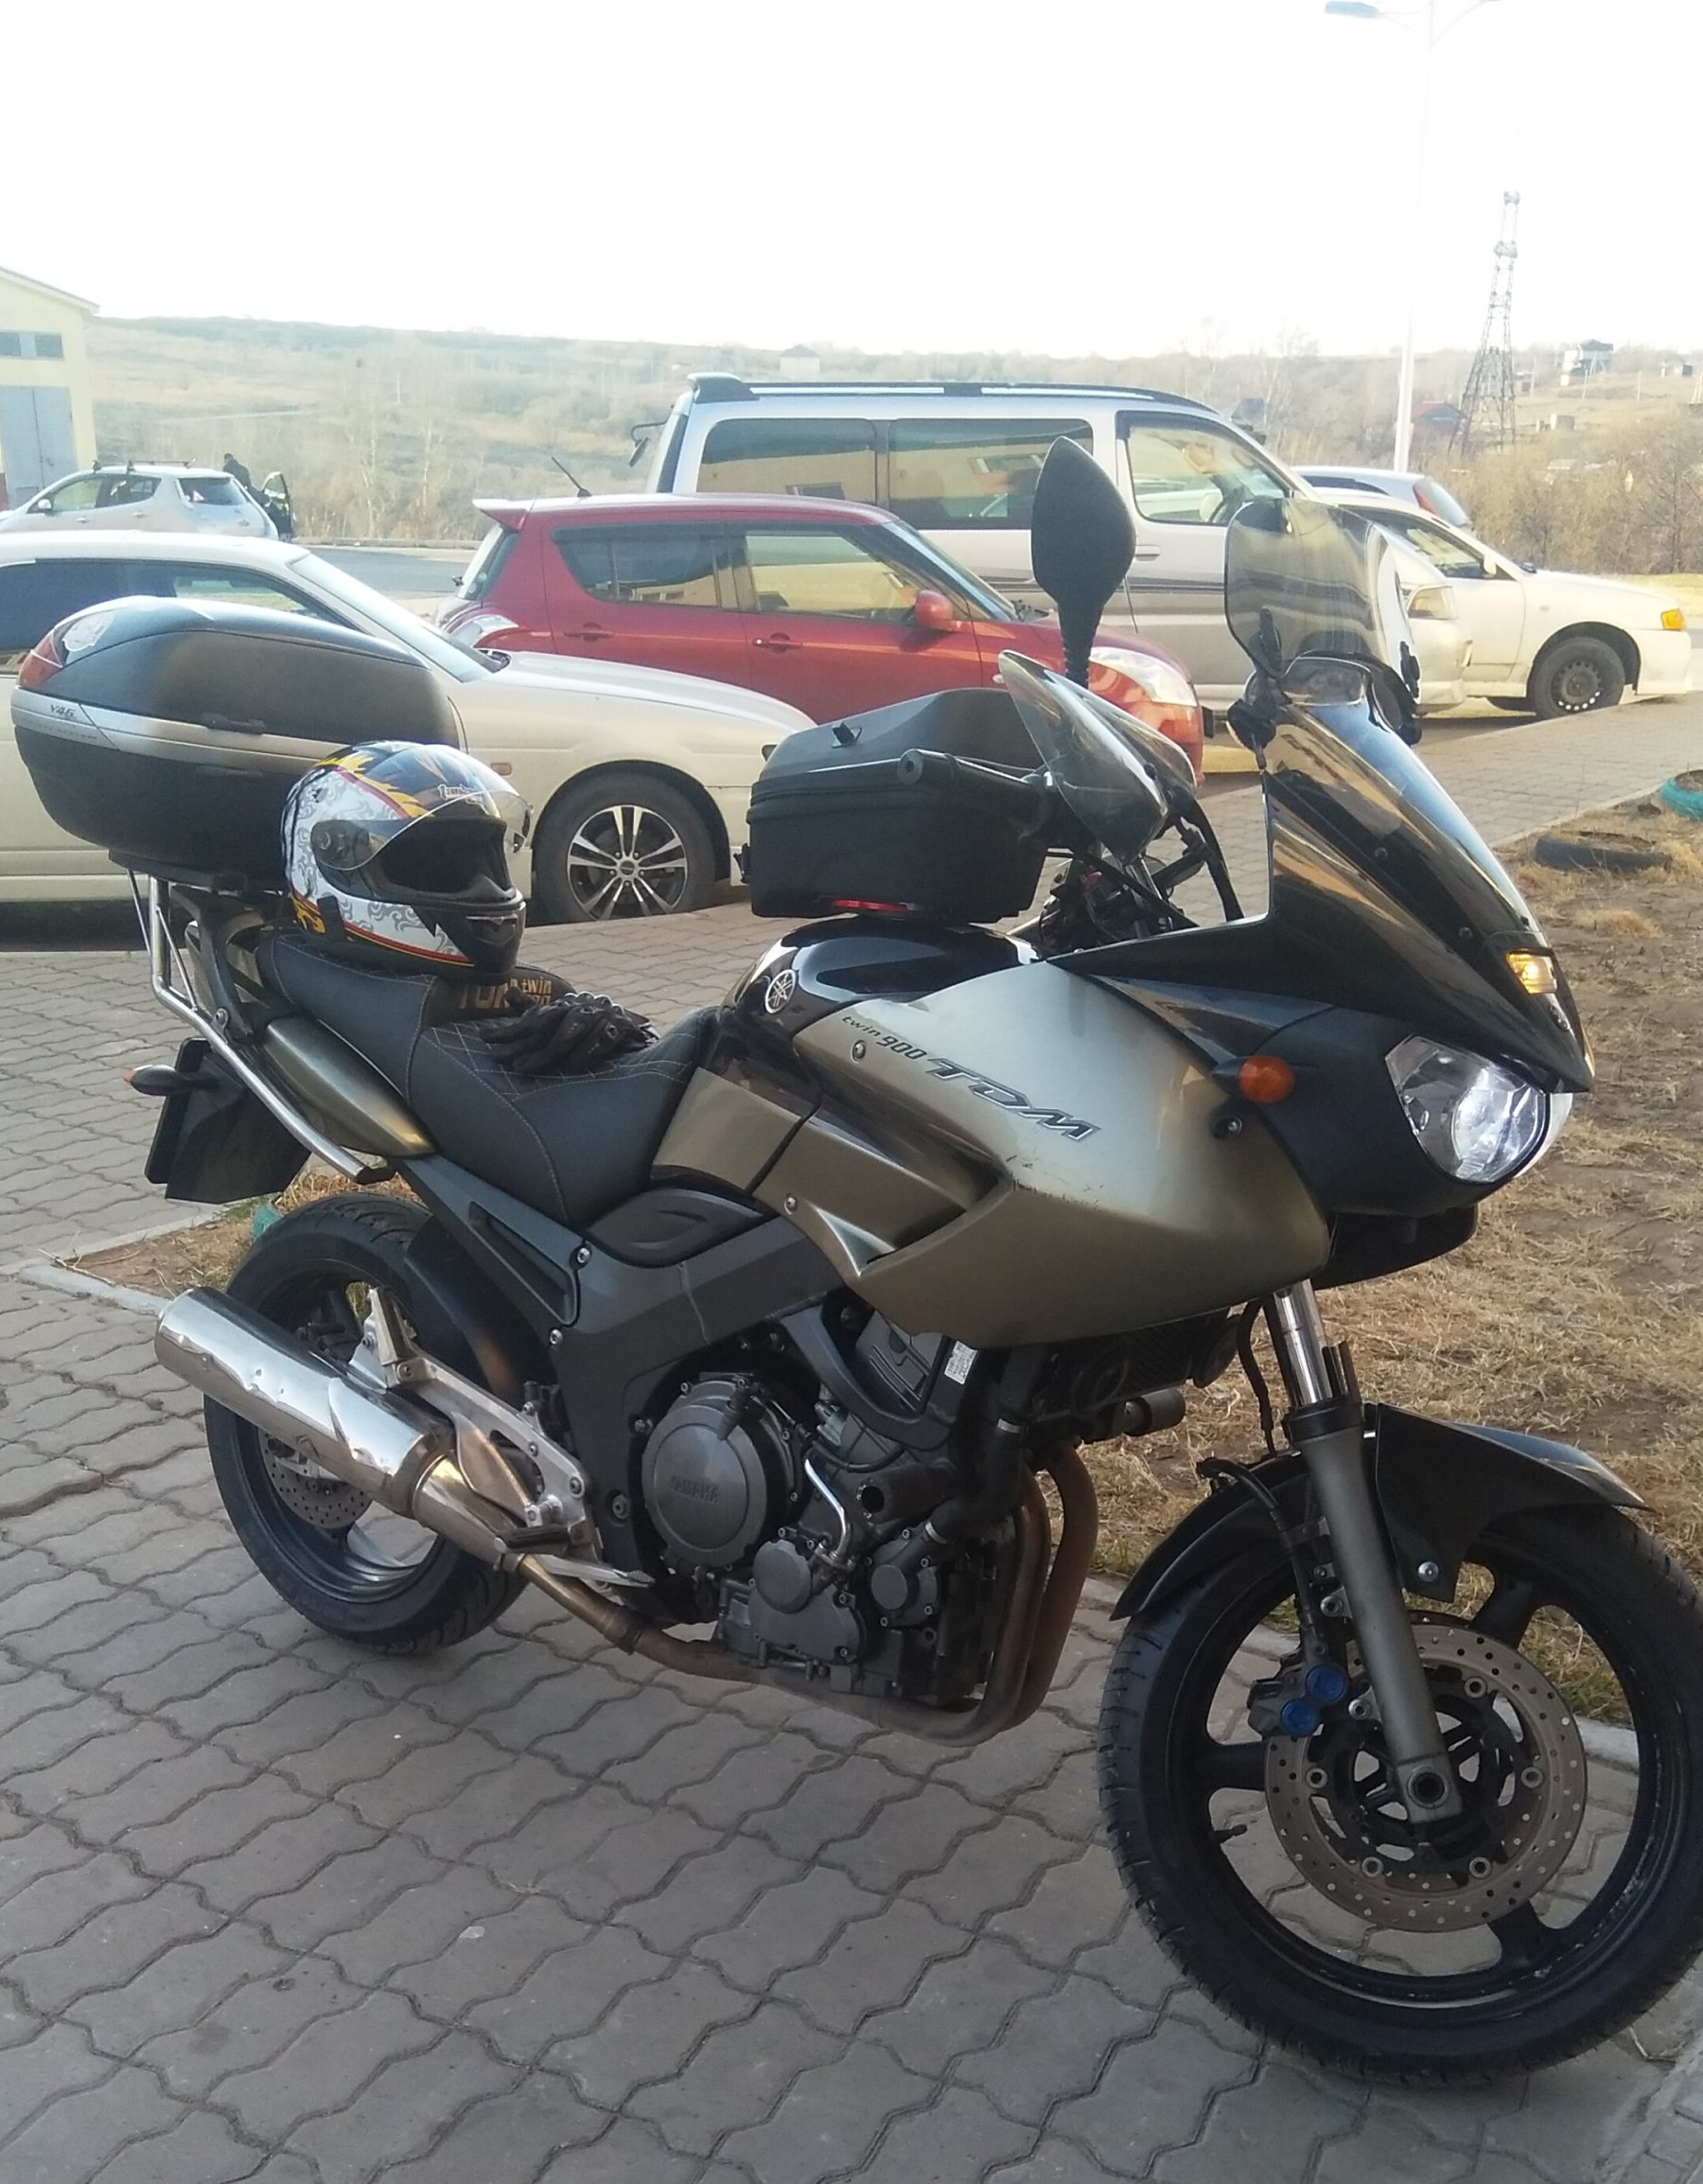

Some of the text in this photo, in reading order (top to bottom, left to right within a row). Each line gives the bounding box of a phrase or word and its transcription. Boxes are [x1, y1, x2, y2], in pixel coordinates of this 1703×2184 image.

[50, 703, 76, 718] V46
[521, 976, 553, 995] twin
[842, 1016, 1101, 1142] twin 900 TDM
